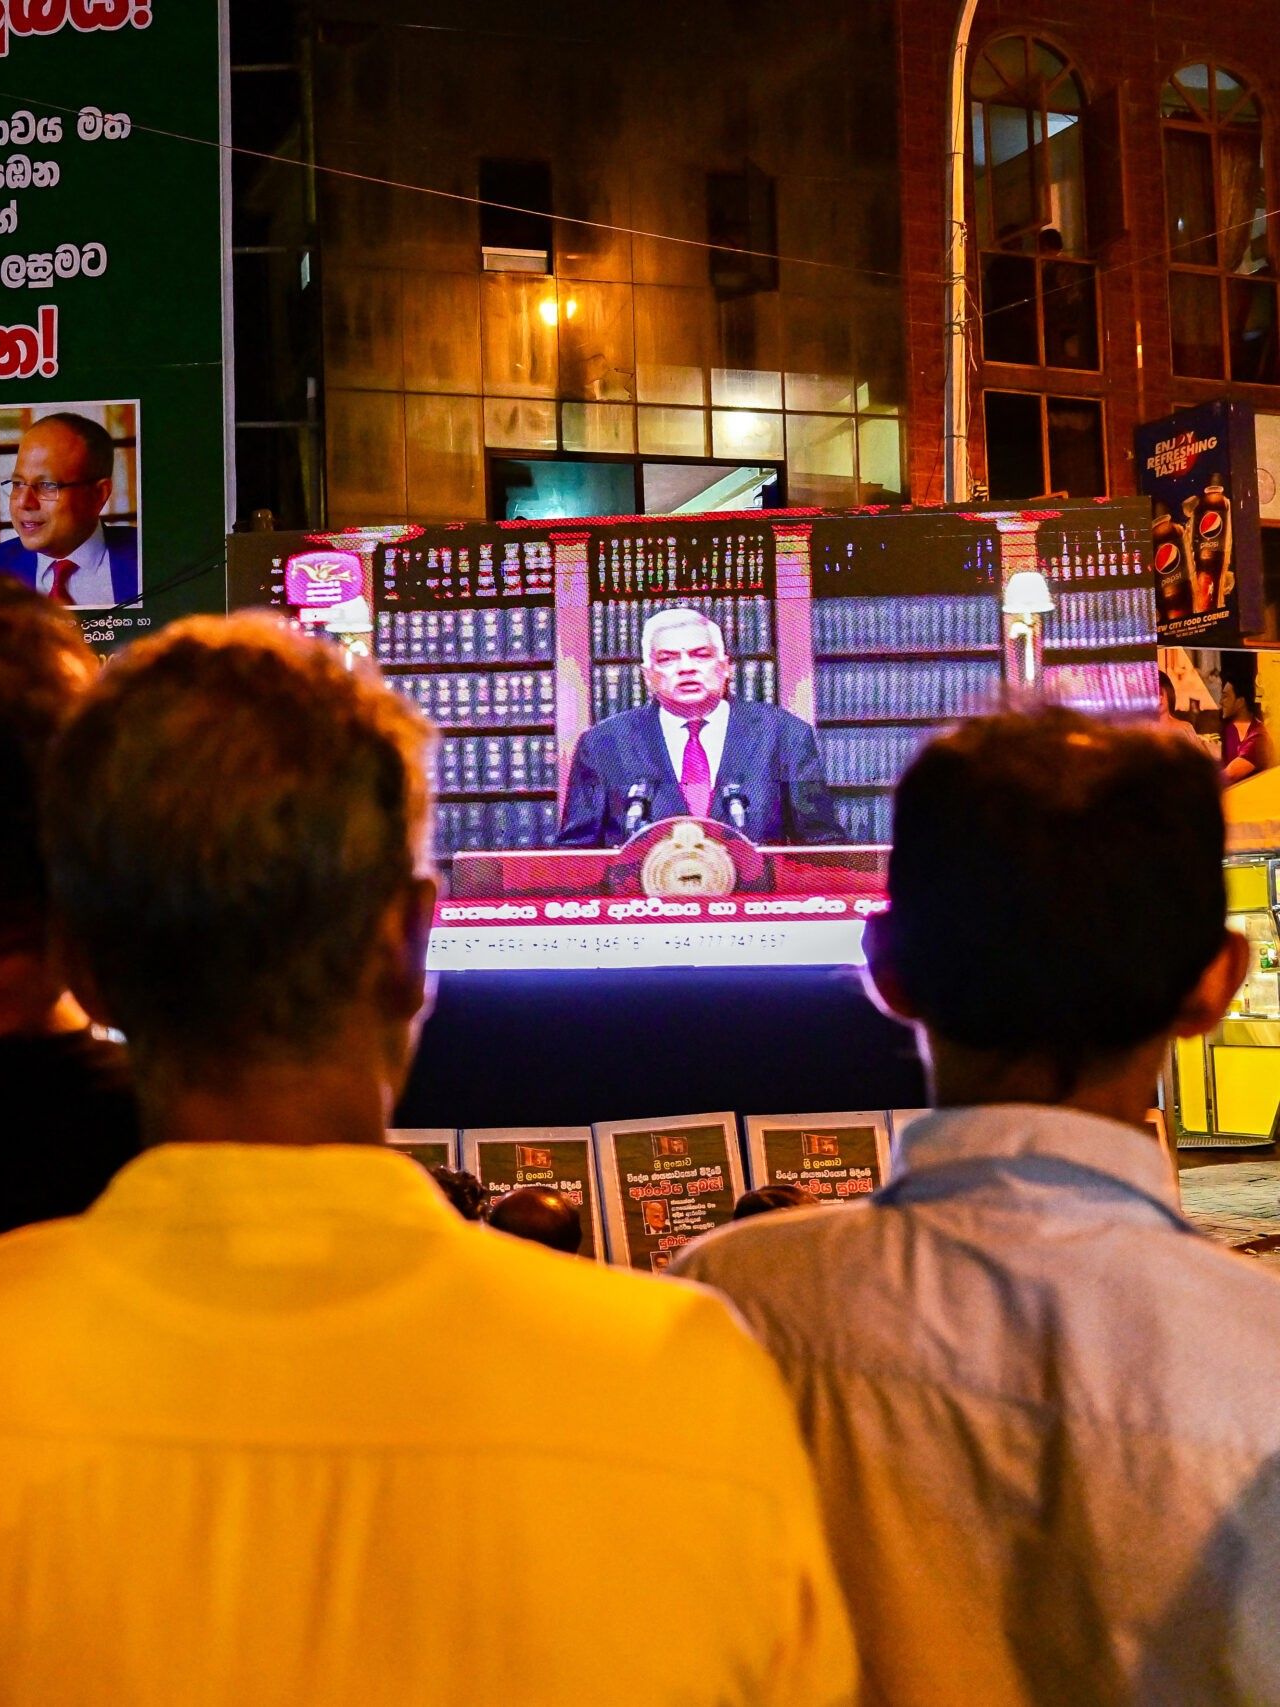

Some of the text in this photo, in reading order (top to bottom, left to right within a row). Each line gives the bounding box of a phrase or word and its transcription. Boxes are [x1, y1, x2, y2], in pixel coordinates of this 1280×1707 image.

[76, 105, 131, 141] මත
[1147, 436, 1217, 469] REFRESHING
[1154, 457, 1188, 478] TASTE
[137, 617, 151, 626] හා
[1157, 625, 1167, 633] EW
[1169, 621, 1182, 630] CITY
[1183, 617, 1201, 626] FOOD
[1203, 611, 1230, 622] CORNER
